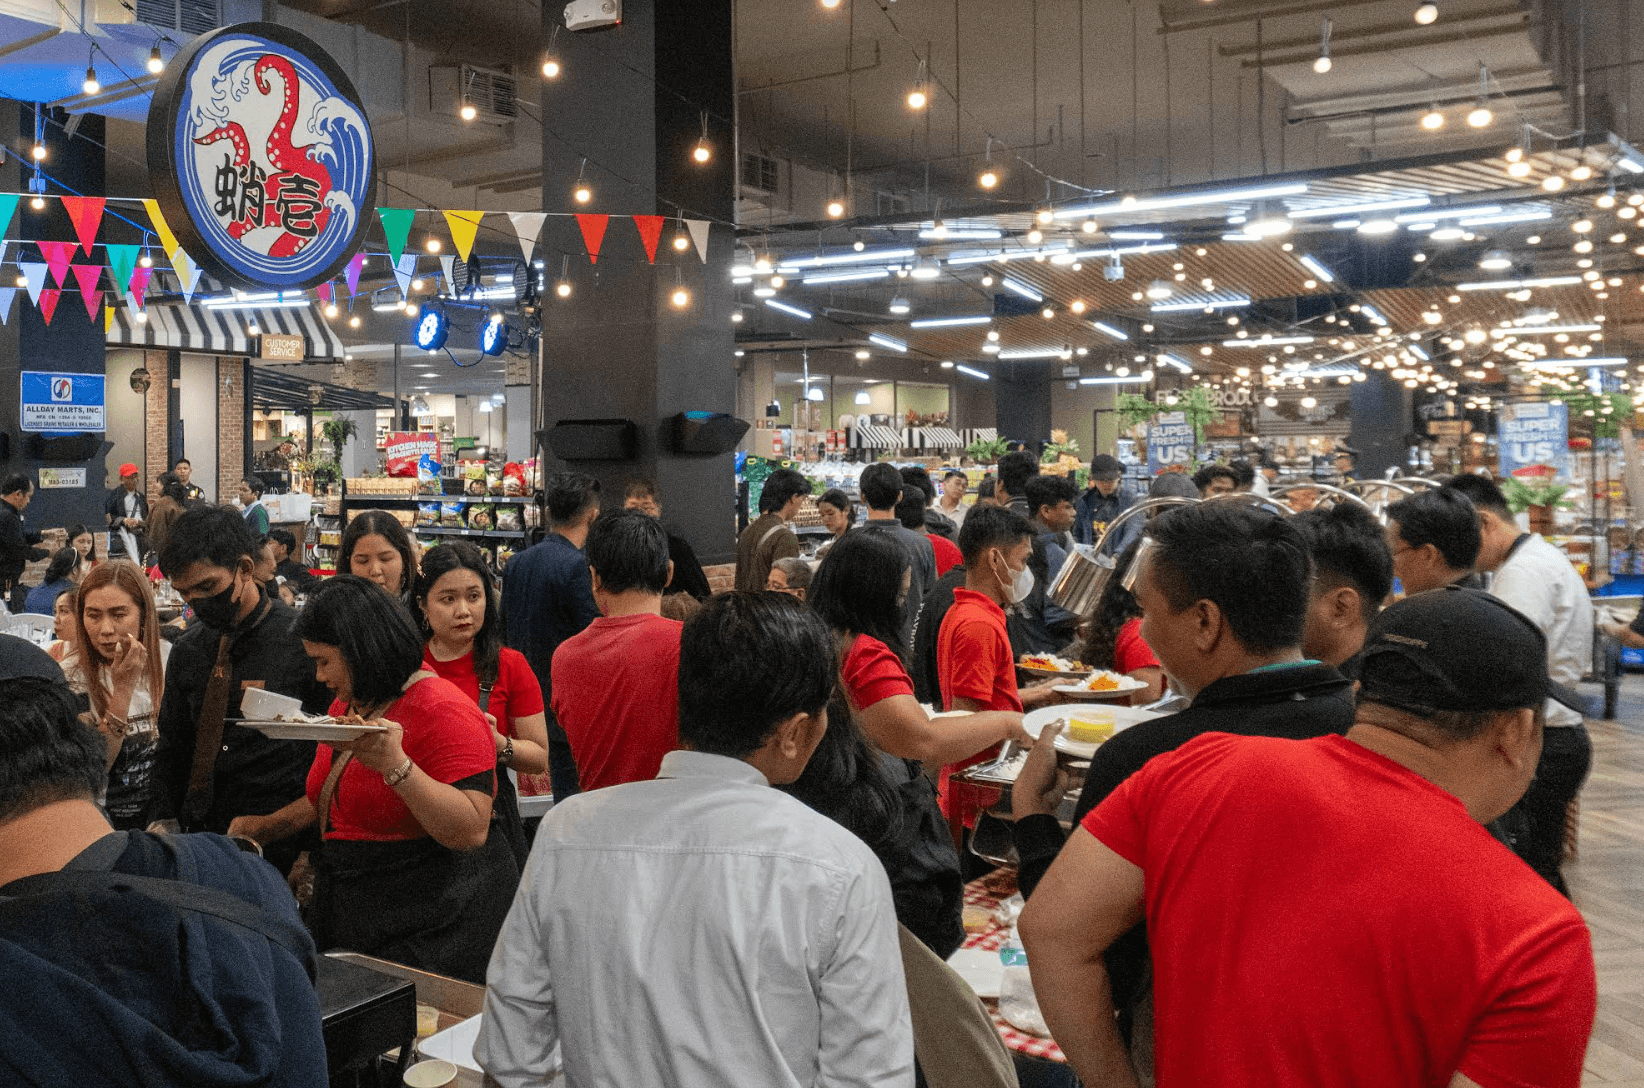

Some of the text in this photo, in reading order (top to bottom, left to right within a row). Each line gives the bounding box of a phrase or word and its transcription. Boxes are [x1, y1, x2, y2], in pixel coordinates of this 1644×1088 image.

[265, 339, 301, 349] CUSTOMER
[270, 347, 296, 357] SERVICE
[57, 407, 85, 415] MARTS,
[1151, 424, 1194, 437] SUPER
[1150, 436, 1184, 446] FRESH
[1157, 445, 1189, 464] US
[1512, 442, 1554, 463] US
[909, 602, 925, 652] PLAYBOY
